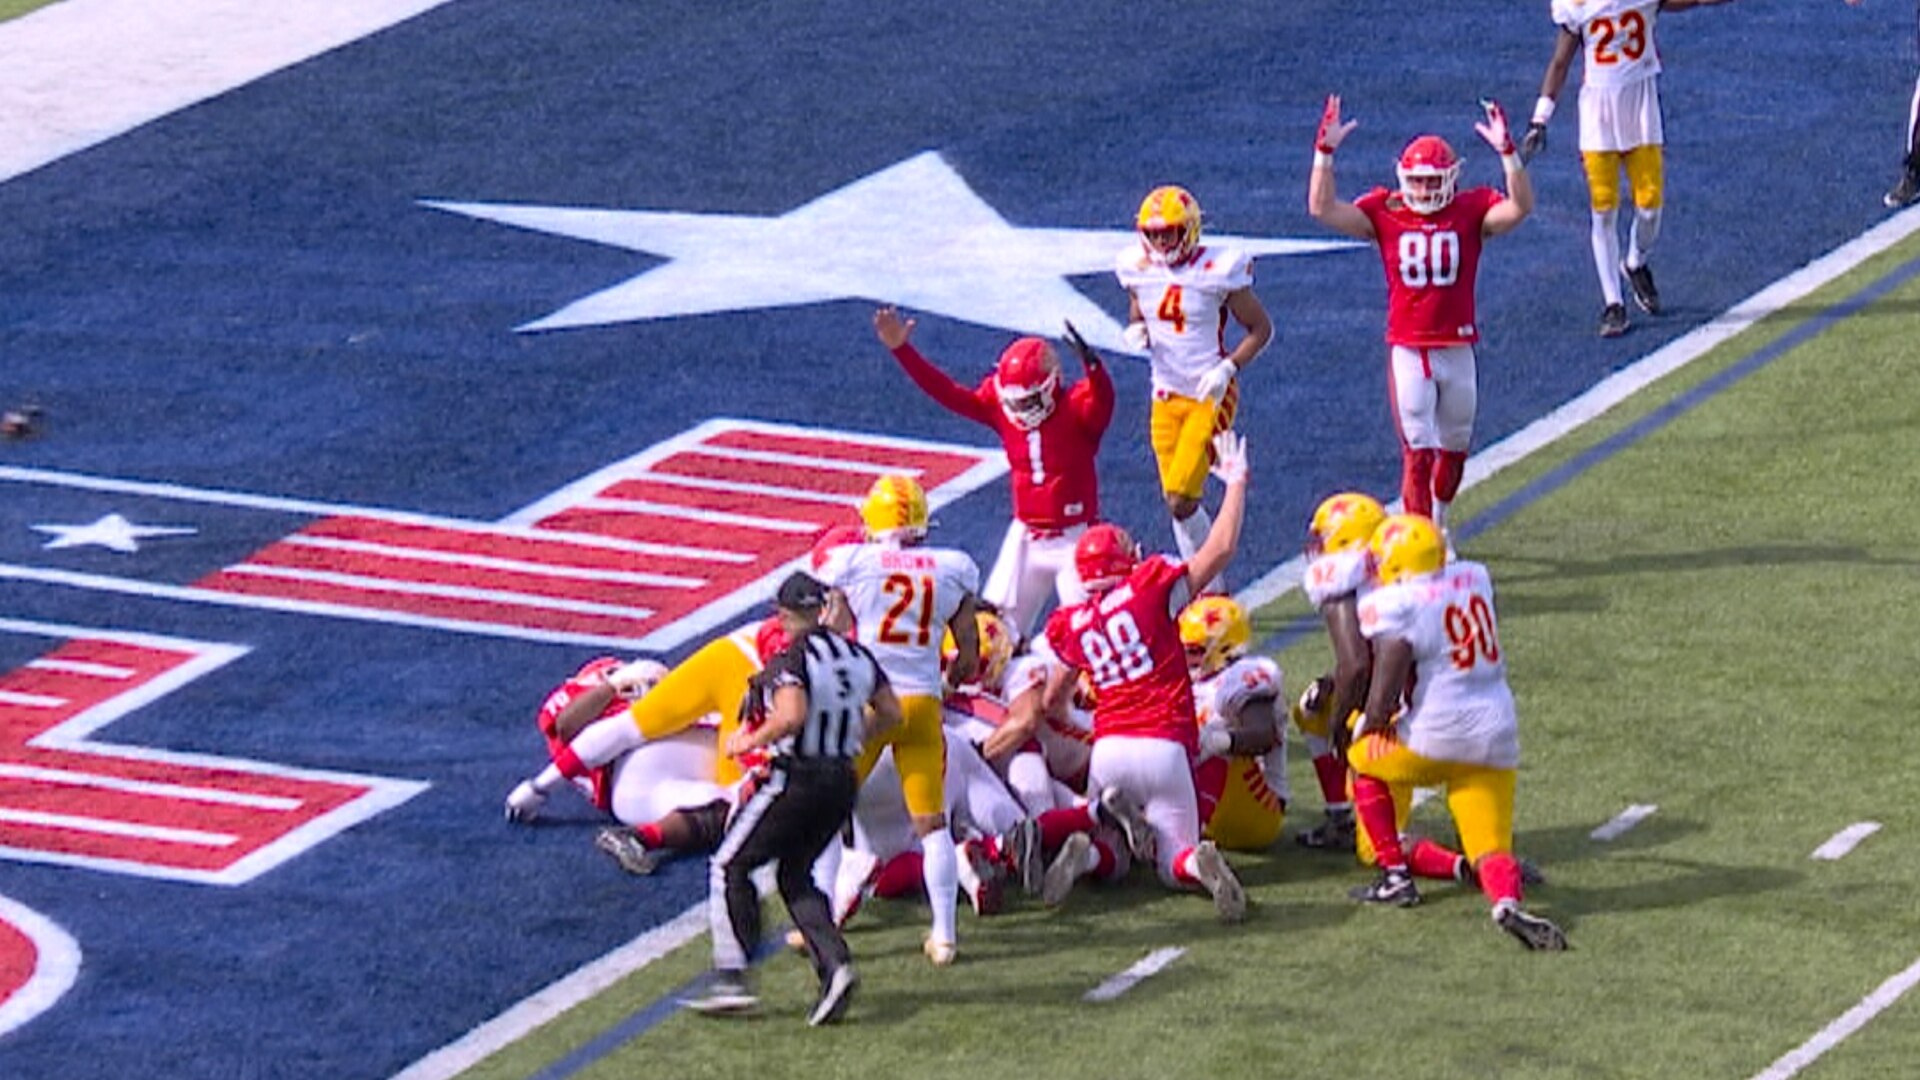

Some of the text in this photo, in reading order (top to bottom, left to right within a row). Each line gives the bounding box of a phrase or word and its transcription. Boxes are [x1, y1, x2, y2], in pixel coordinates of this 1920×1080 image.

[1588, 10, 1648, 64] 23
[1398, 231, 1460, 288] 80
[1157, 284, 1188, 334] 4
[1026, 429, 1045, 485] 1
[880, 551, 937, 571] BROWN
[877, 573, 935, 647] 21
[1443, 593, 1500, 673] 90
[1080, 610, 1155, 692] 88
